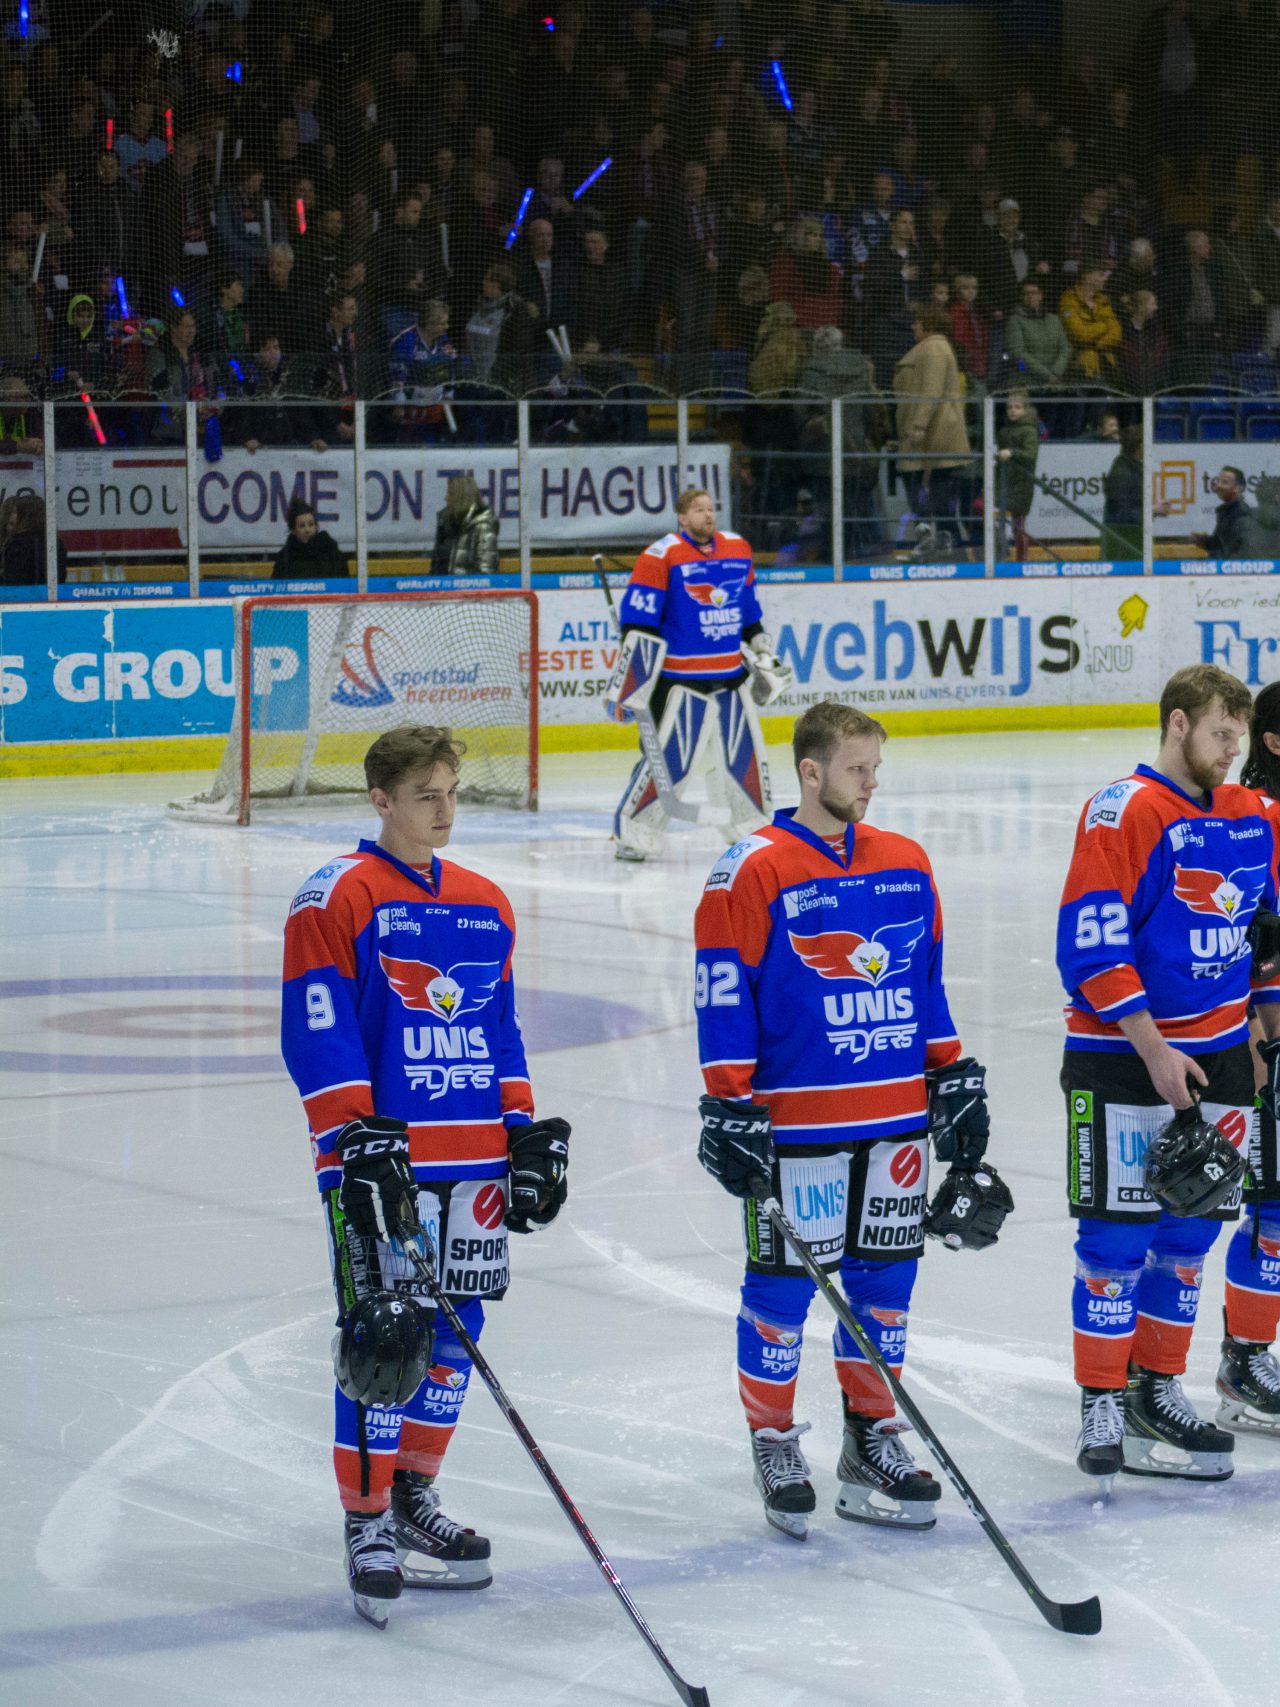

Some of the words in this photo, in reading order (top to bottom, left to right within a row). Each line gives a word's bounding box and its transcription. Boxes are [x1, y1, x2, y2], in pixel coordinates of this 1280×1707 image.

[198, 470, 339, 524] COME
[366, 469, 422, 521] ON
[869, 567, 904, 579] UNIS
[907, 566, 957, 578] GROUP
[1022, 564, 1057, 576] UNIS
[1061, 563, 1113, 575] GROUP
[1180, 562, 1217, 574] UNIS
[1221, 561, 1274, 573] GROUP
[228, 583, 274, 595] QUALITY
[287, 582, 326, 593] REPAIR
[396, 579, 441, 590] QUALITY
[453, 577, 491, 588] REPAIR
[558, 575, 595, 588] UNIS
[72, 586, 120, 598] QUALITY
[132, 585, 174, 596] REPAIR
[1194, 590, 1242, 608] Voor
[629, 589, 657, 614] 41
[699, 607, 742, 626] UNIS
[559, 621, 618, 643] ALTI
[53, 649, 299, 703] GROUP
[392, 663, 480, 686] sportstad
[405, 685, 512, 704] heerenveen
[824, 690, 886, 704] PARTNER
[889, 688, 917, 701] VAN
[920, 687, 951, 699] UNIS
[955, 685, 1006, 699] FLYERS
[640, 721, 668, 793] BAUER
[798, 883, 819, 899] post
[839, 878, 866, 888] CCM
[425, 908, 451, 916] CCM
[799, 894, 839, 912] cleaning
[306, 982, 336, 1031] 9
[823, 986, 915, 1026] UNIS
[403, 1026, 490, 1060] UNIS
[826, 1021, 919, 1065] FLYERS
[937, 1076, 986, 1096] CC
[702, 1113, 771, 1134] CCM
[342, 1138, 409, 1161] CCM
[1078, 1127, 1093, 1200] VANPLAN.NL
[795, 1178, 846, 1222] UNIS
[810, 1236, 845, 1255] ROUP
[1087, 1300, 1133, 1314] UNIS
[1087, 1312, 1133, 1326] FLYERS
[859, 1465, 884, 1485] CCM
[402, 1525, 434, 1548] CCM
